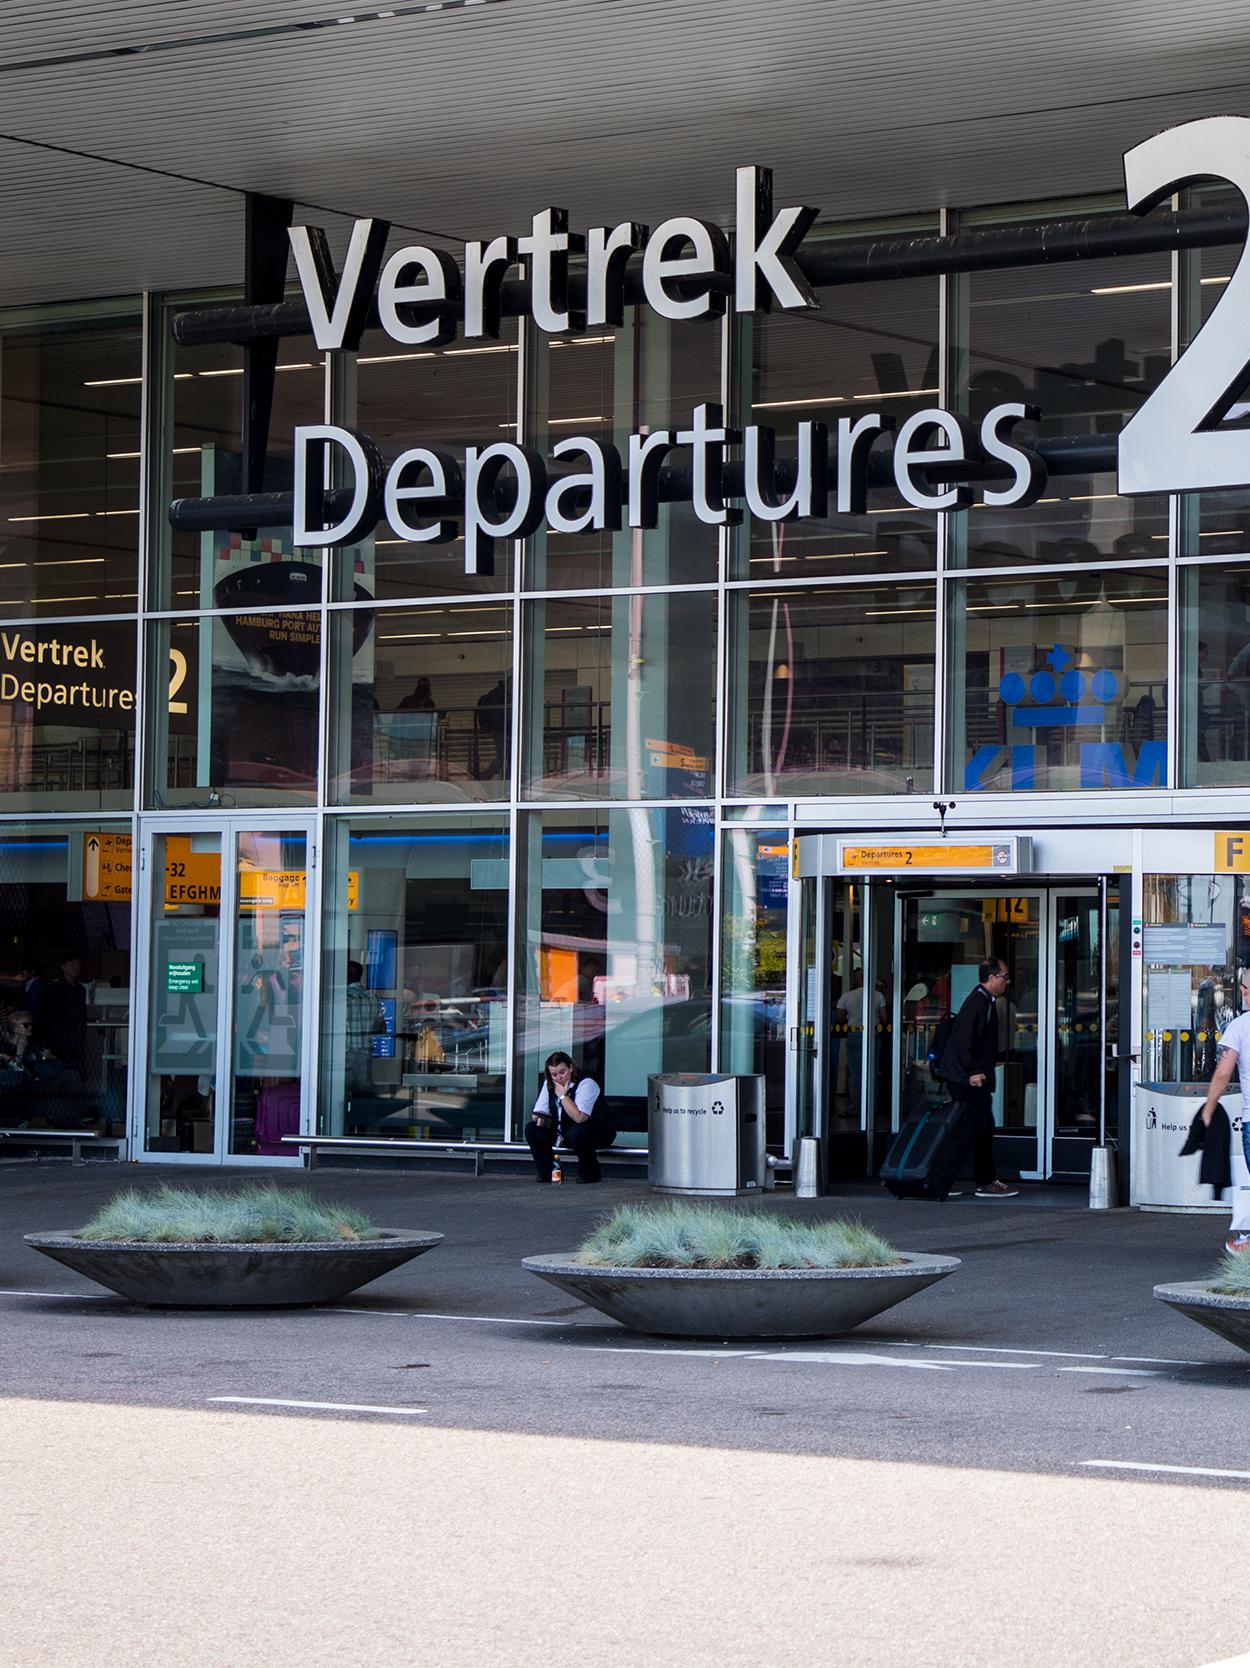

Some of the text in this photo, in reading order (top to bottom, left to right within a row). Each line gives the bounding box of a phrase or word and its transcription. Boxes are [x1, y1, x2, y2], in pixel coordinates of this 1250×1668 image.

[287, 165, 821, 352] Vertrek
[292, 401, 1047, 576] Departures
[235, 615, 280, 630] HAMBURG
[282, 619, 305, 631] PORT
[269, 630, 321, 644] RUN SIMPLE
[1, 632, 105, 669] Vertrek
[0, 673, 138, 710] Departure
[861, 850, 912, 865] Departures 2
[1226, 837, 1244, 867] F
[263, 873, 300, 882] Baggage
[662, 1107, 672, 1115] Help
[687, 1107, 707, 1116] recycle
[1161, 1123, 1178, 1132] Help
